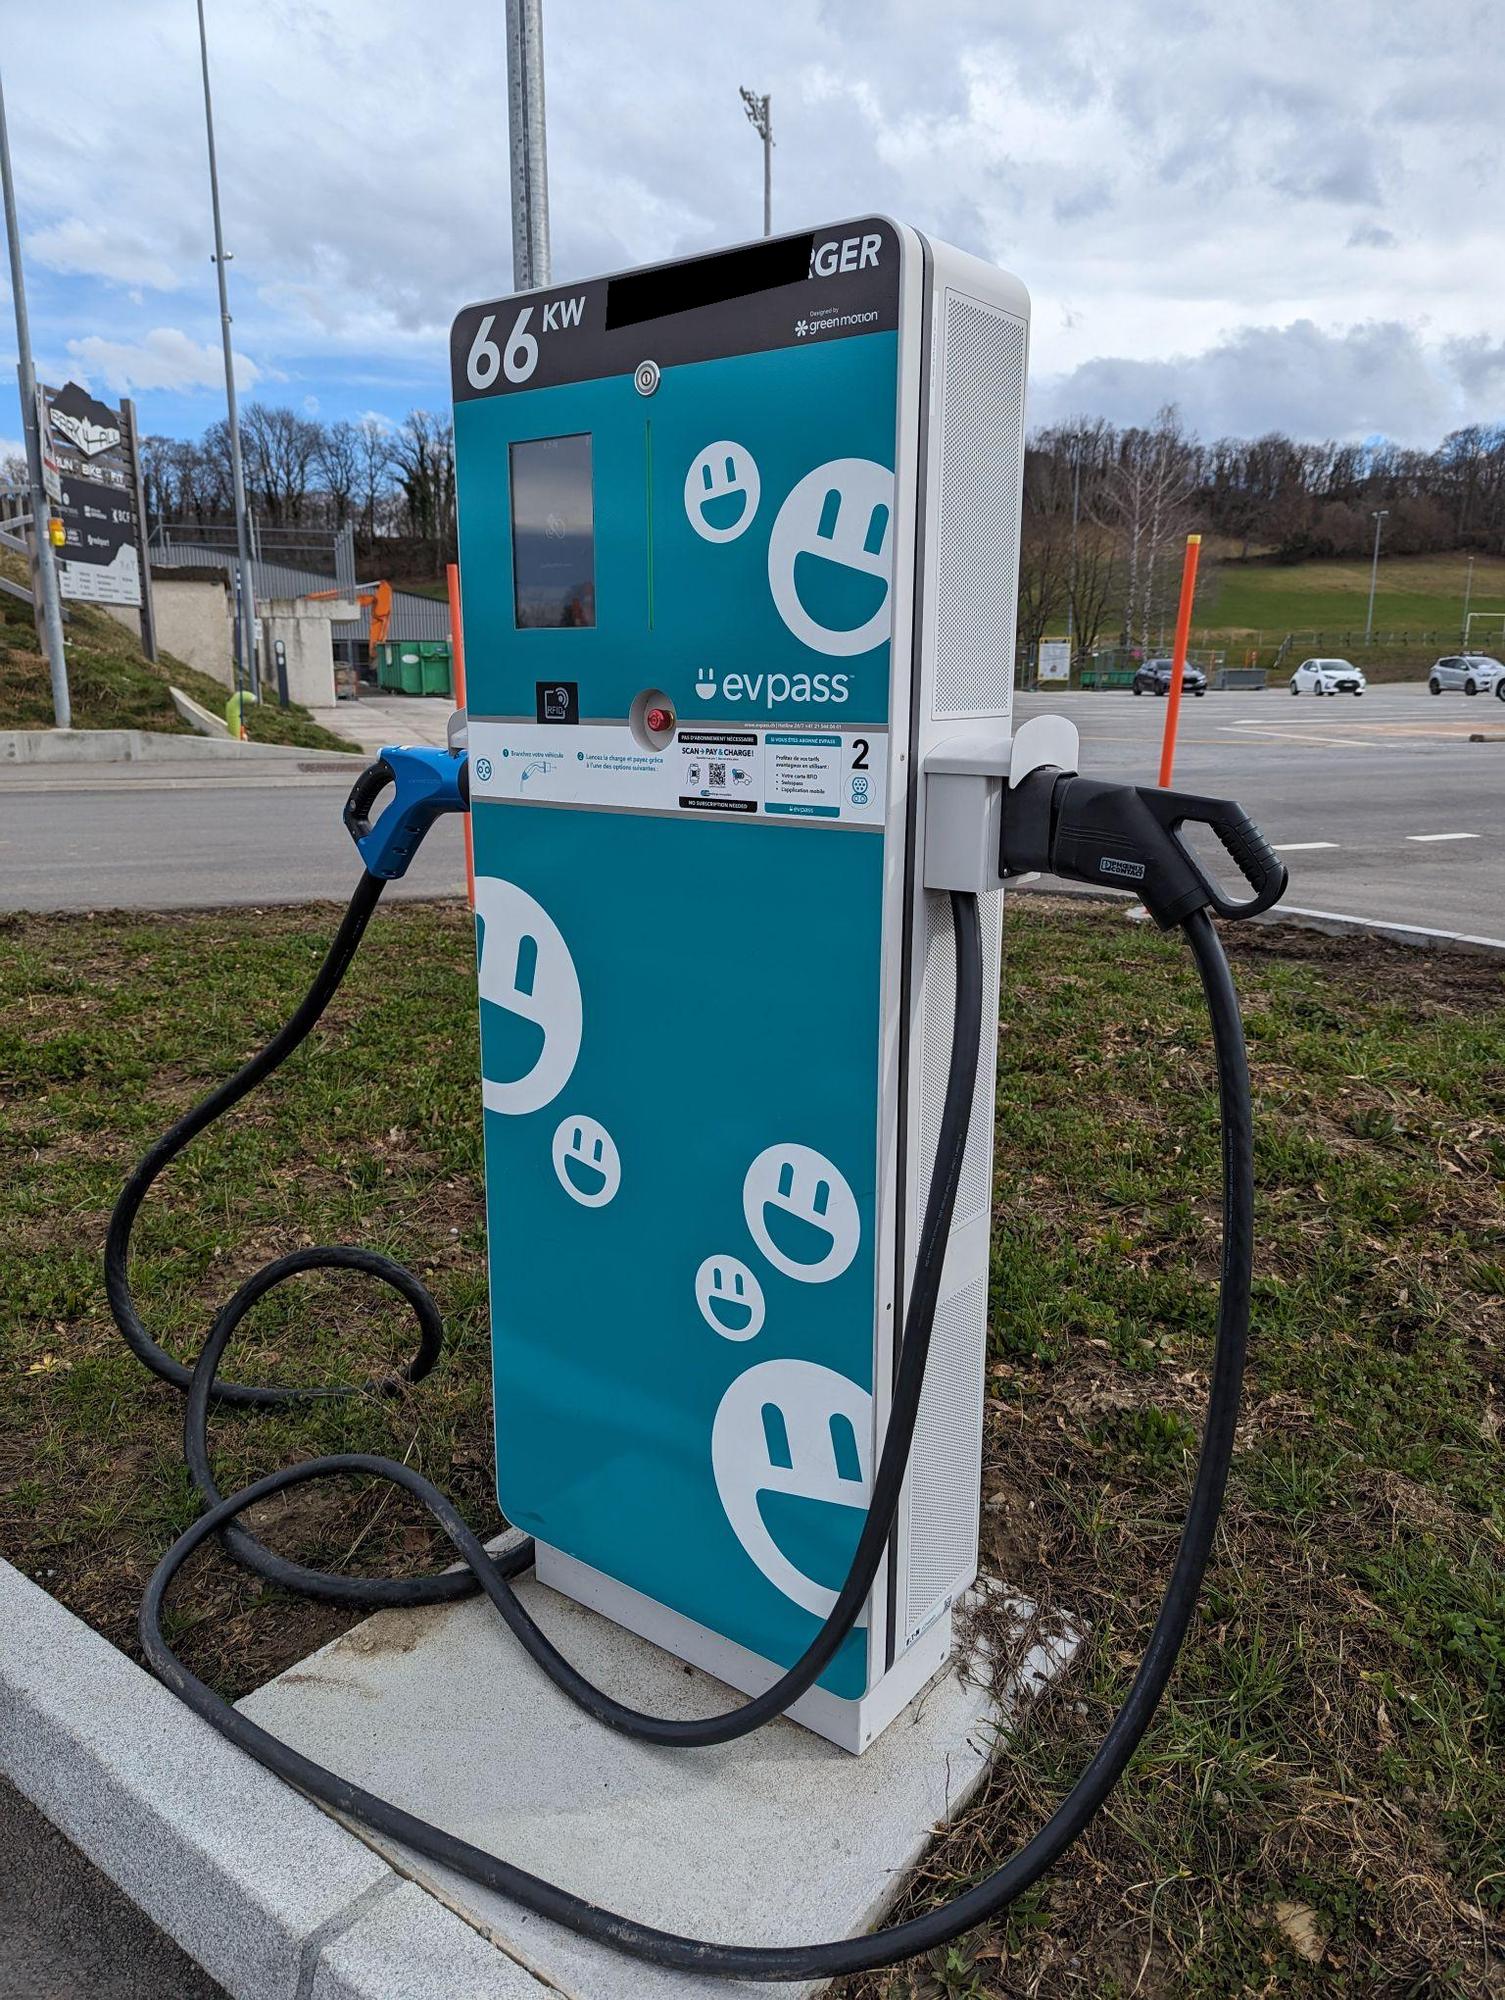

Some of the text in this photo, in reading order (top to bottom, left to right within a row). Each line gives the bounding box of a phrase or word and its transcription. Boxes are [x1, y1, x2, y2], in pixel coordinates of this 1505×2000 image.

[810, 308, 832, 317] Designed
[467, 296, 586, 390] 66 KW
[722, 673, 849, 709] evpass
[547, 706, 563, 715] RFID
[682, 747, 699, 755] SCAN
[705, 748, 718, 756] PAY
[852, 739, 869, 769] 2
